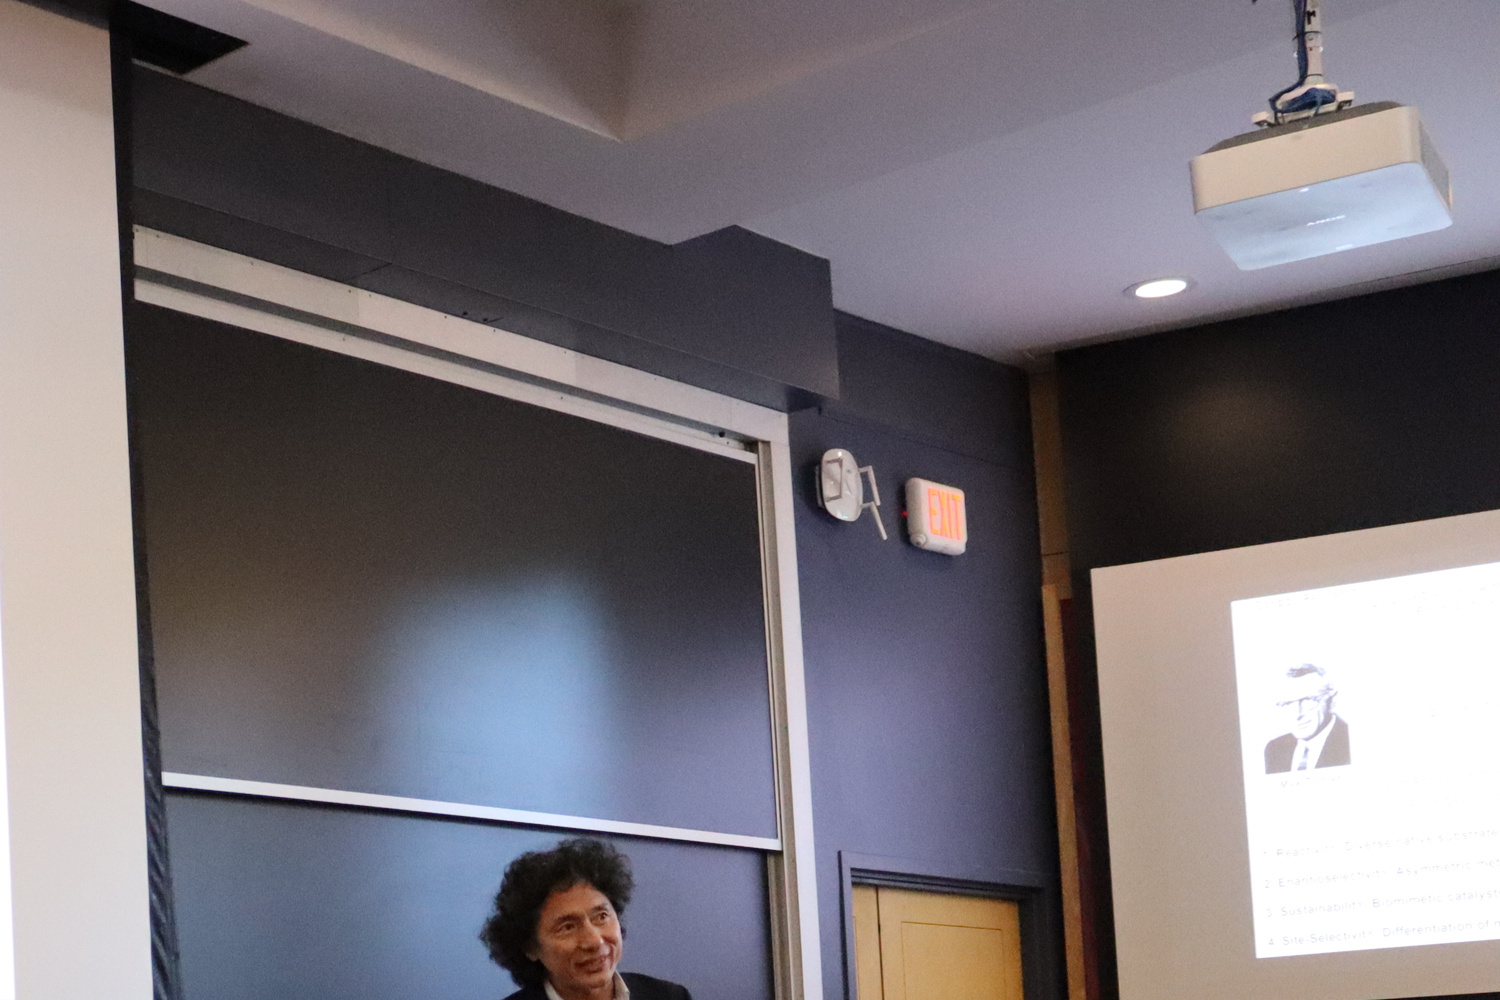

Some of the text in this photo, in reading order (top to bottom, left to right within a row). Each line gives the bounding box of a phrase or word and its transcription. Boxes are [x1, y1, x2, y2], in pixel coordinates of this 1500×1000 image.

[928, 487, 962, 540] EXIT
[1382, 921, 1473, 937] Differentiation
[1477, 919, 1489, 929] of
